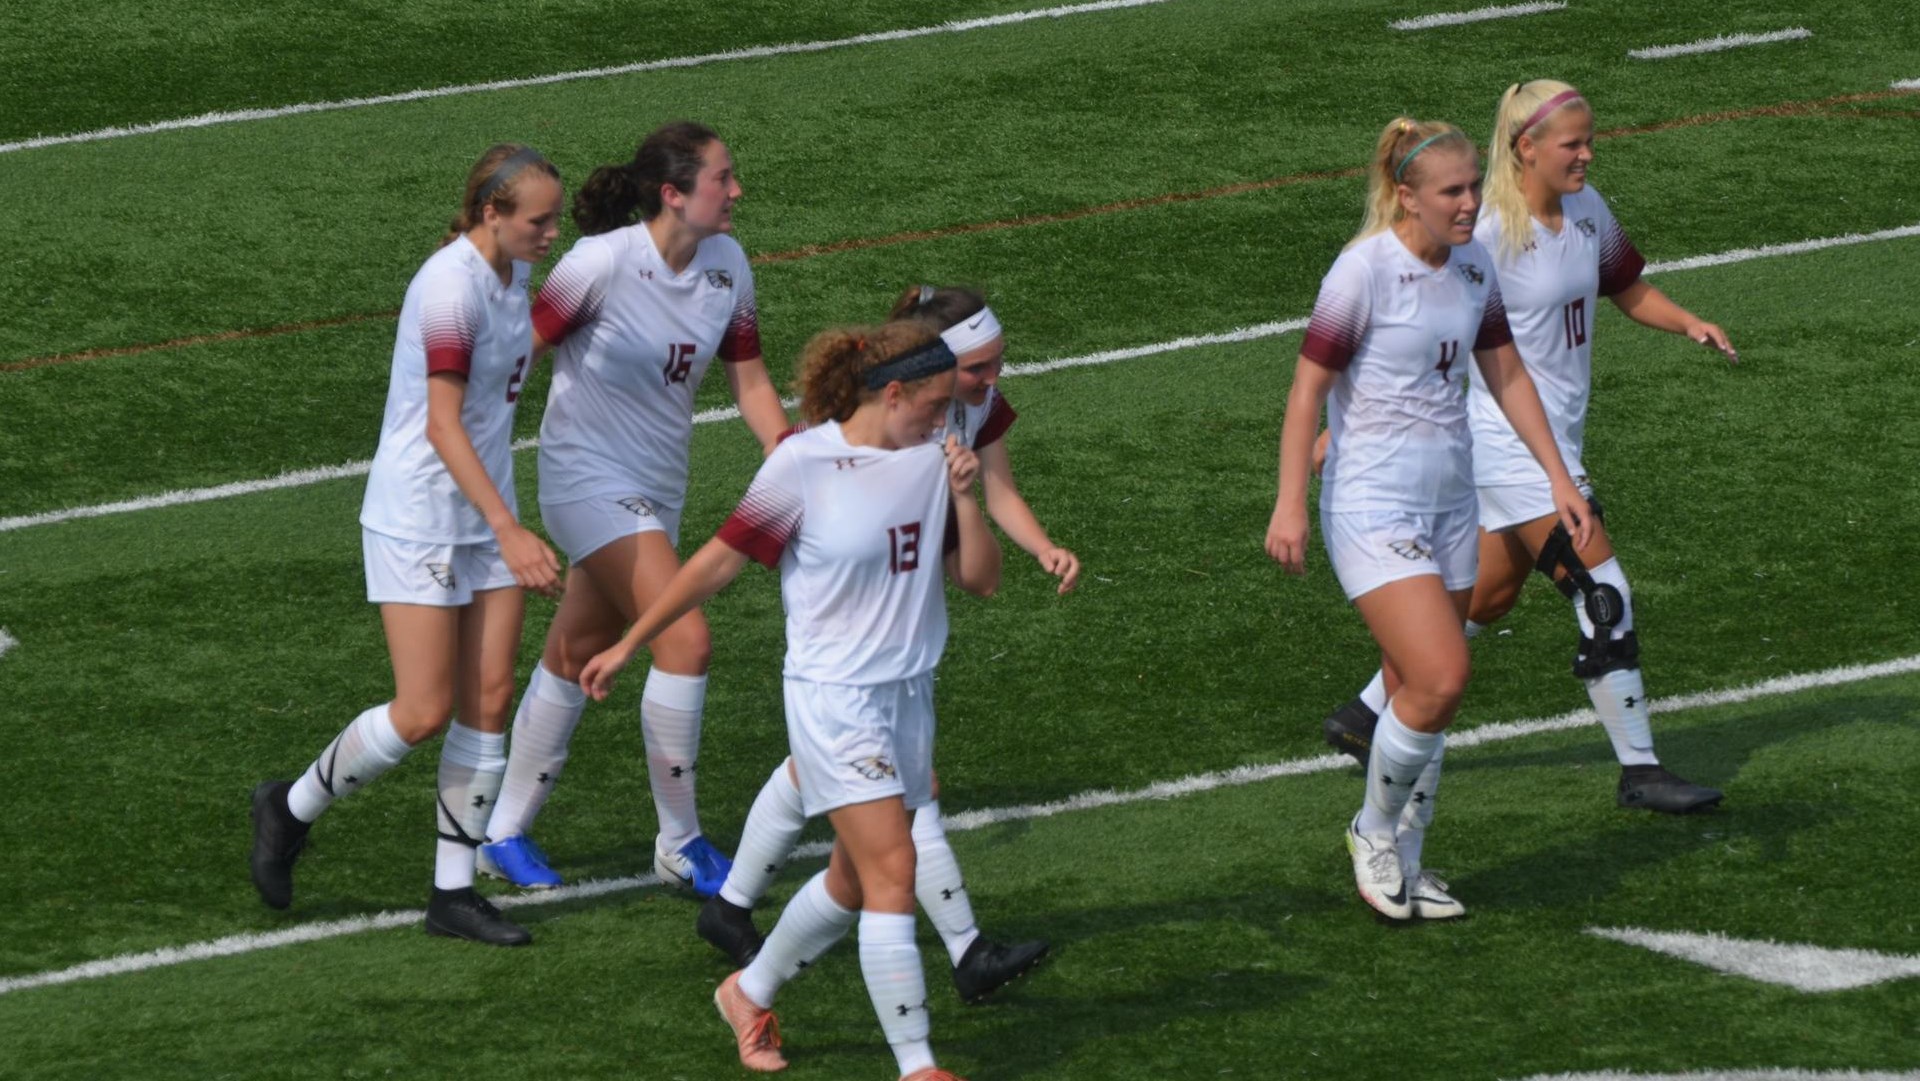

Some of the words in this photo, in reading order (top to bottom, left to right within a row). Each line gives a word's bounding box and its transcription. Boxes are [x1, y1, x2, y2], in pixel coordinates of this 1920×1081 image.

[1564, 297, 1586, 350] 10
[663, 343, 696, 386] 16
[1435, 340, 1458, 383] 4
[887, 521, 920, 576] 13
